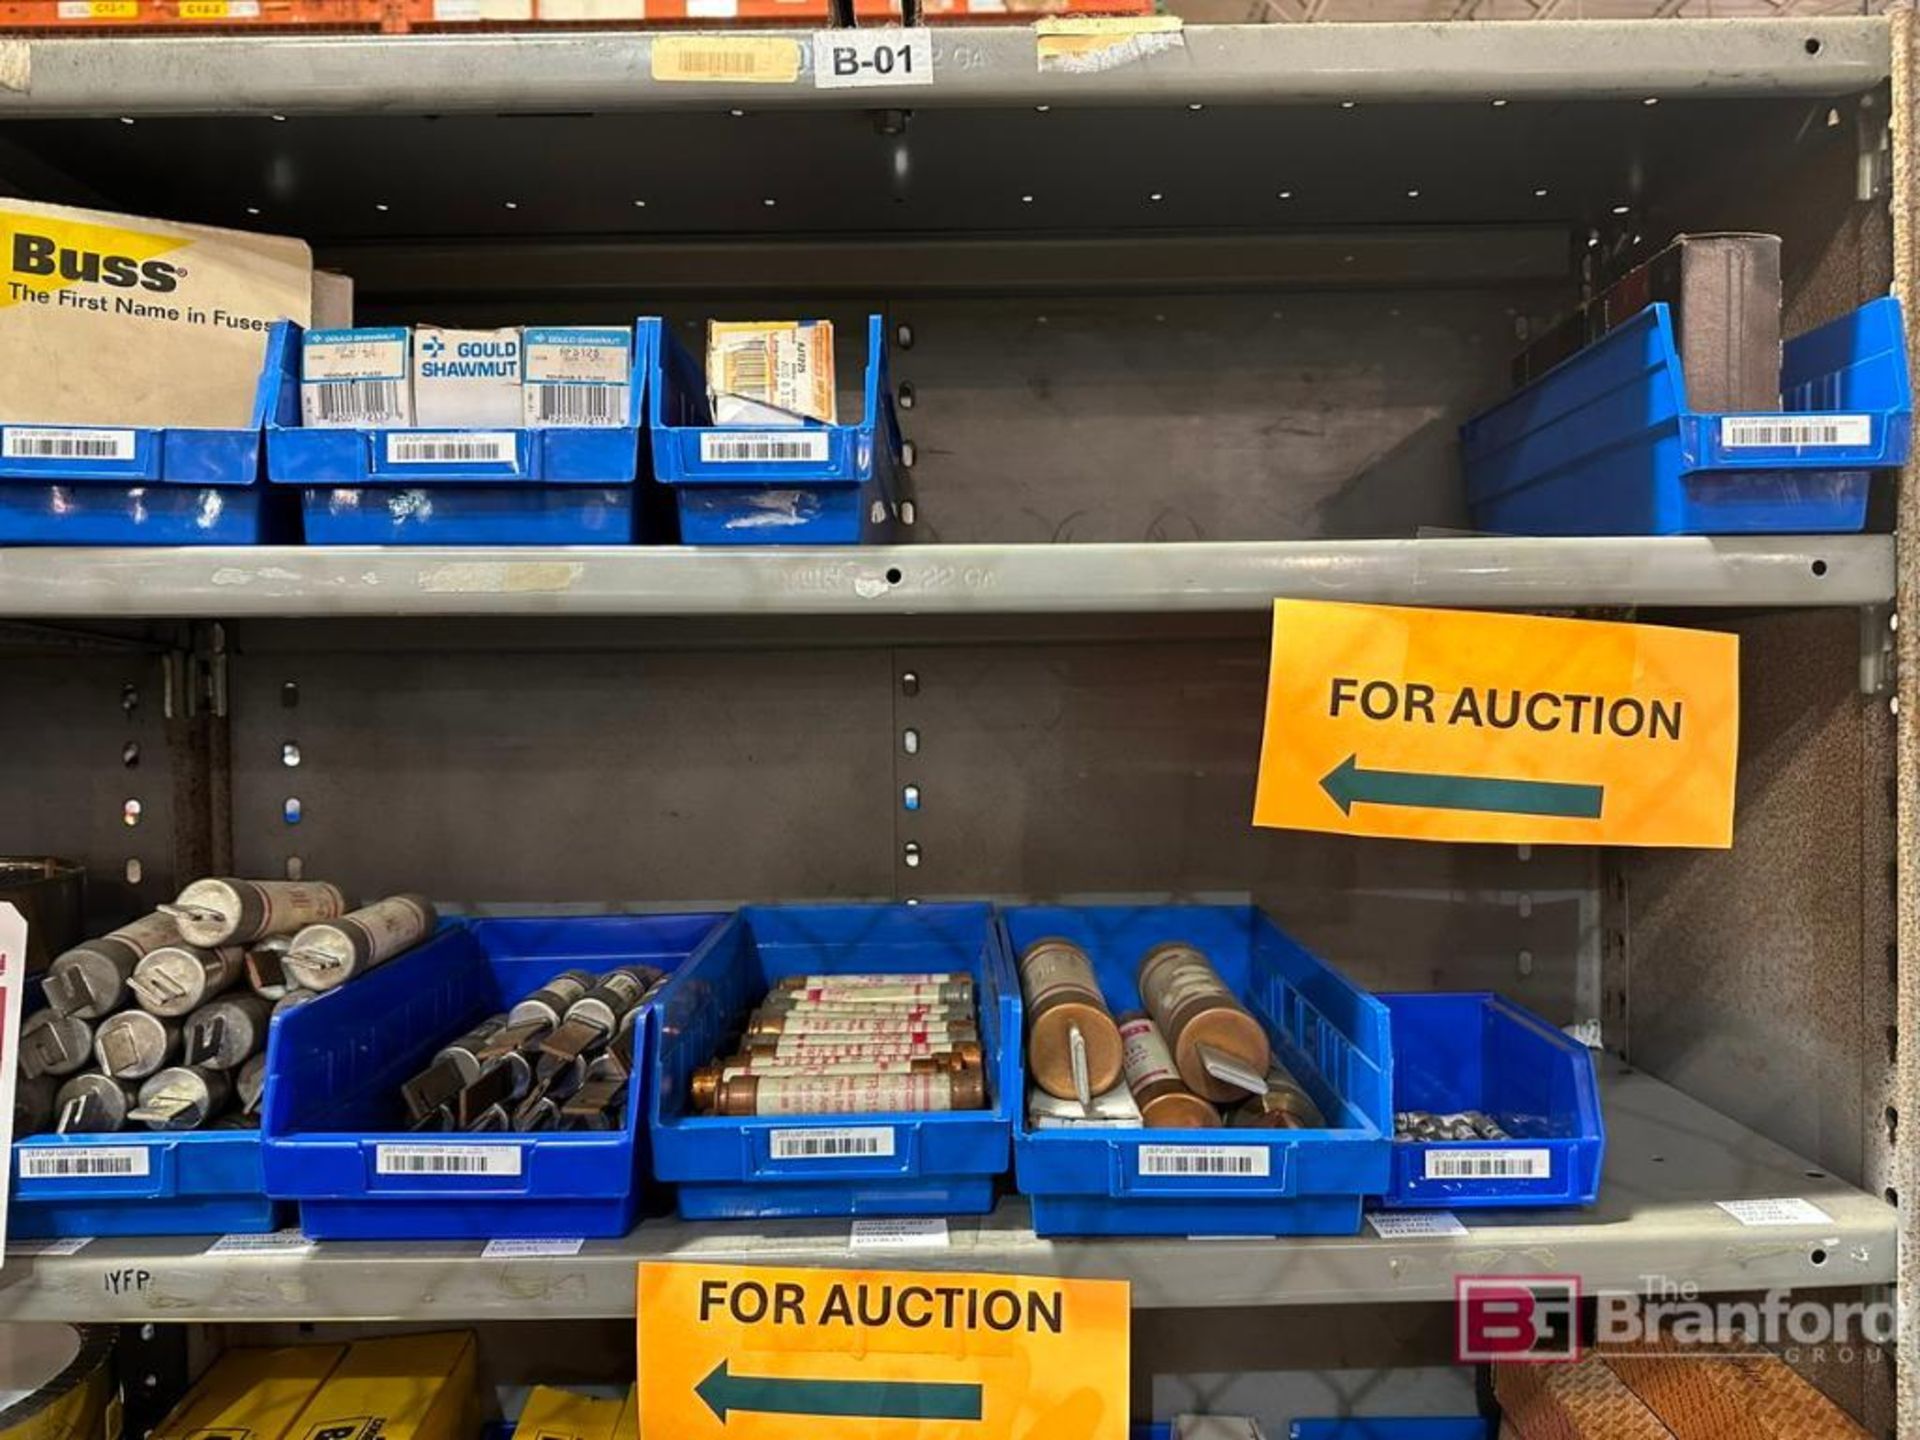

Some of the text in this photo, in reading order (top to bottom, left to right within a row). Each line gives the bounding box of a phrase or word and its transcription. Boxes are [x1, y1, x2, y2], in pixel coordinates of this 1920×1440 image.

[832, 44, 914, 76] B-01
[8, 282, 273, 333] The First Name in Fuses
[421, 360, 518, 377] SHAWMUT
[457, 342, 517, 358] GOULD
[1329, 678, 1684, 741] FOR AUCTION
[699, 1280, 1063, 1334] FOR AUCTION
